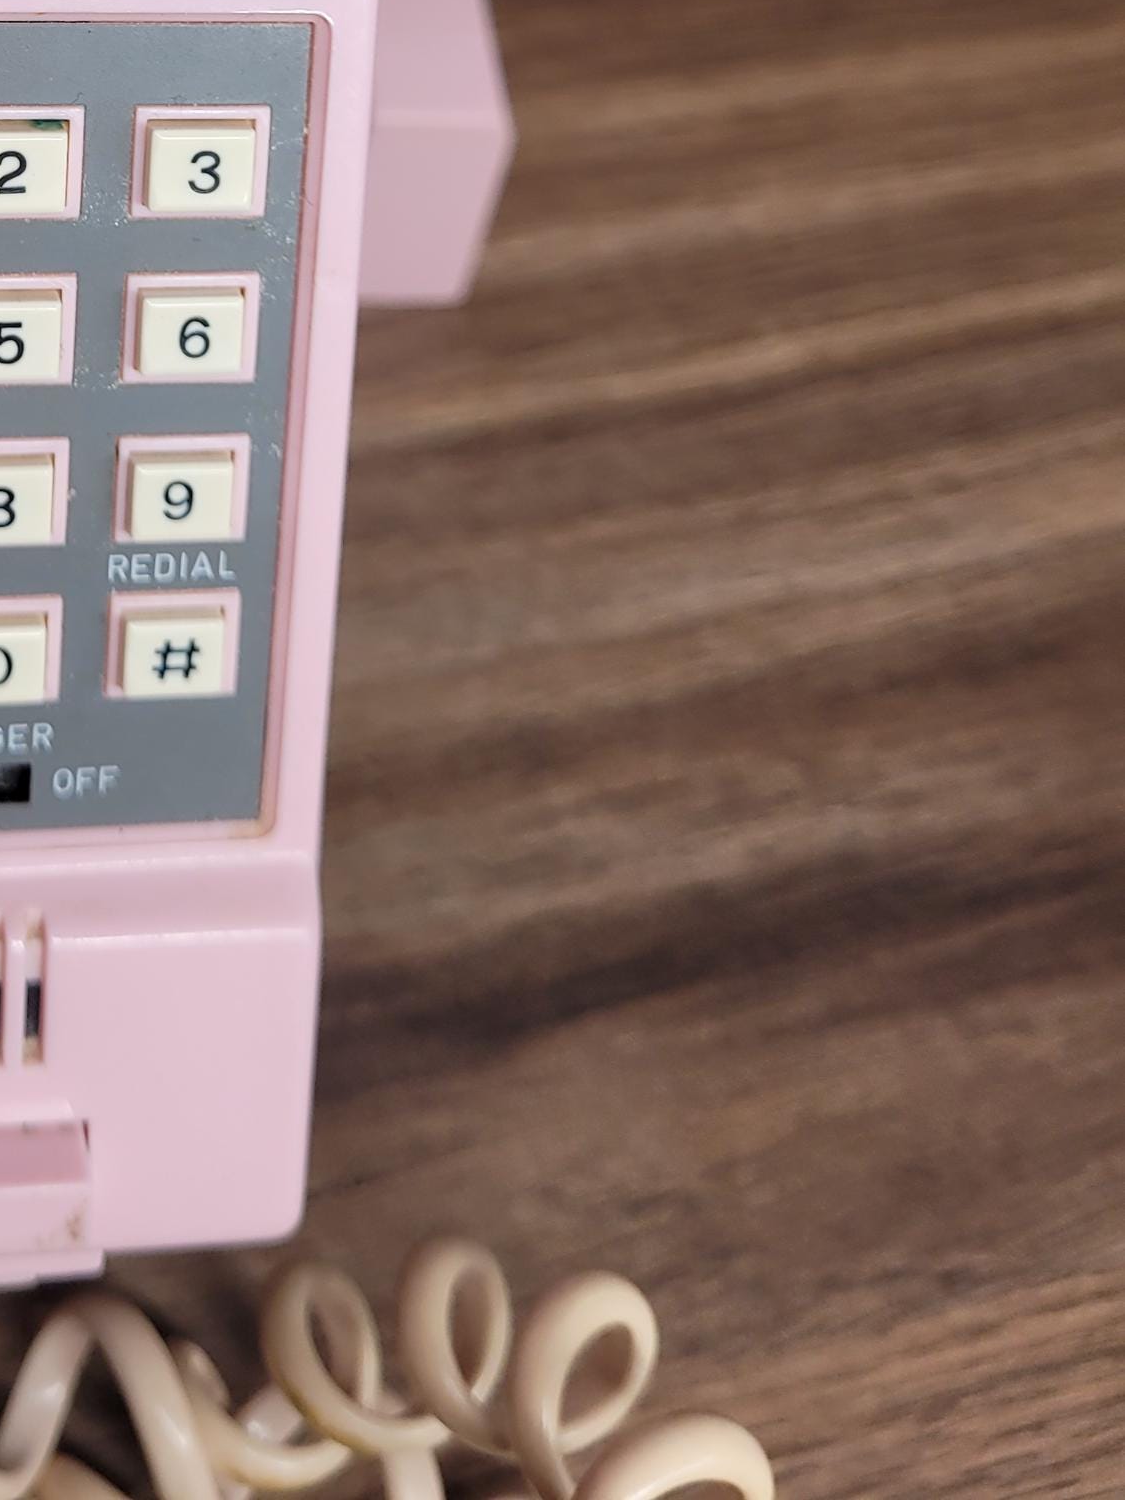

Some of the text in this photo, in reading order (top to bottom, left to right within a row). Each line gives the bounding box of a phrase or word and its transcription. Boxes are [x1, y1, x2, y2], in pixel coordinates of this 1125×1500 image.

[187, 150, 222, 195] 3
[177, 317, 212, 360] 6
[162, 480, 195, 522] 9
[107, 550, 237, 583] REDIAL
[52, 764, 121, 799] OFF
